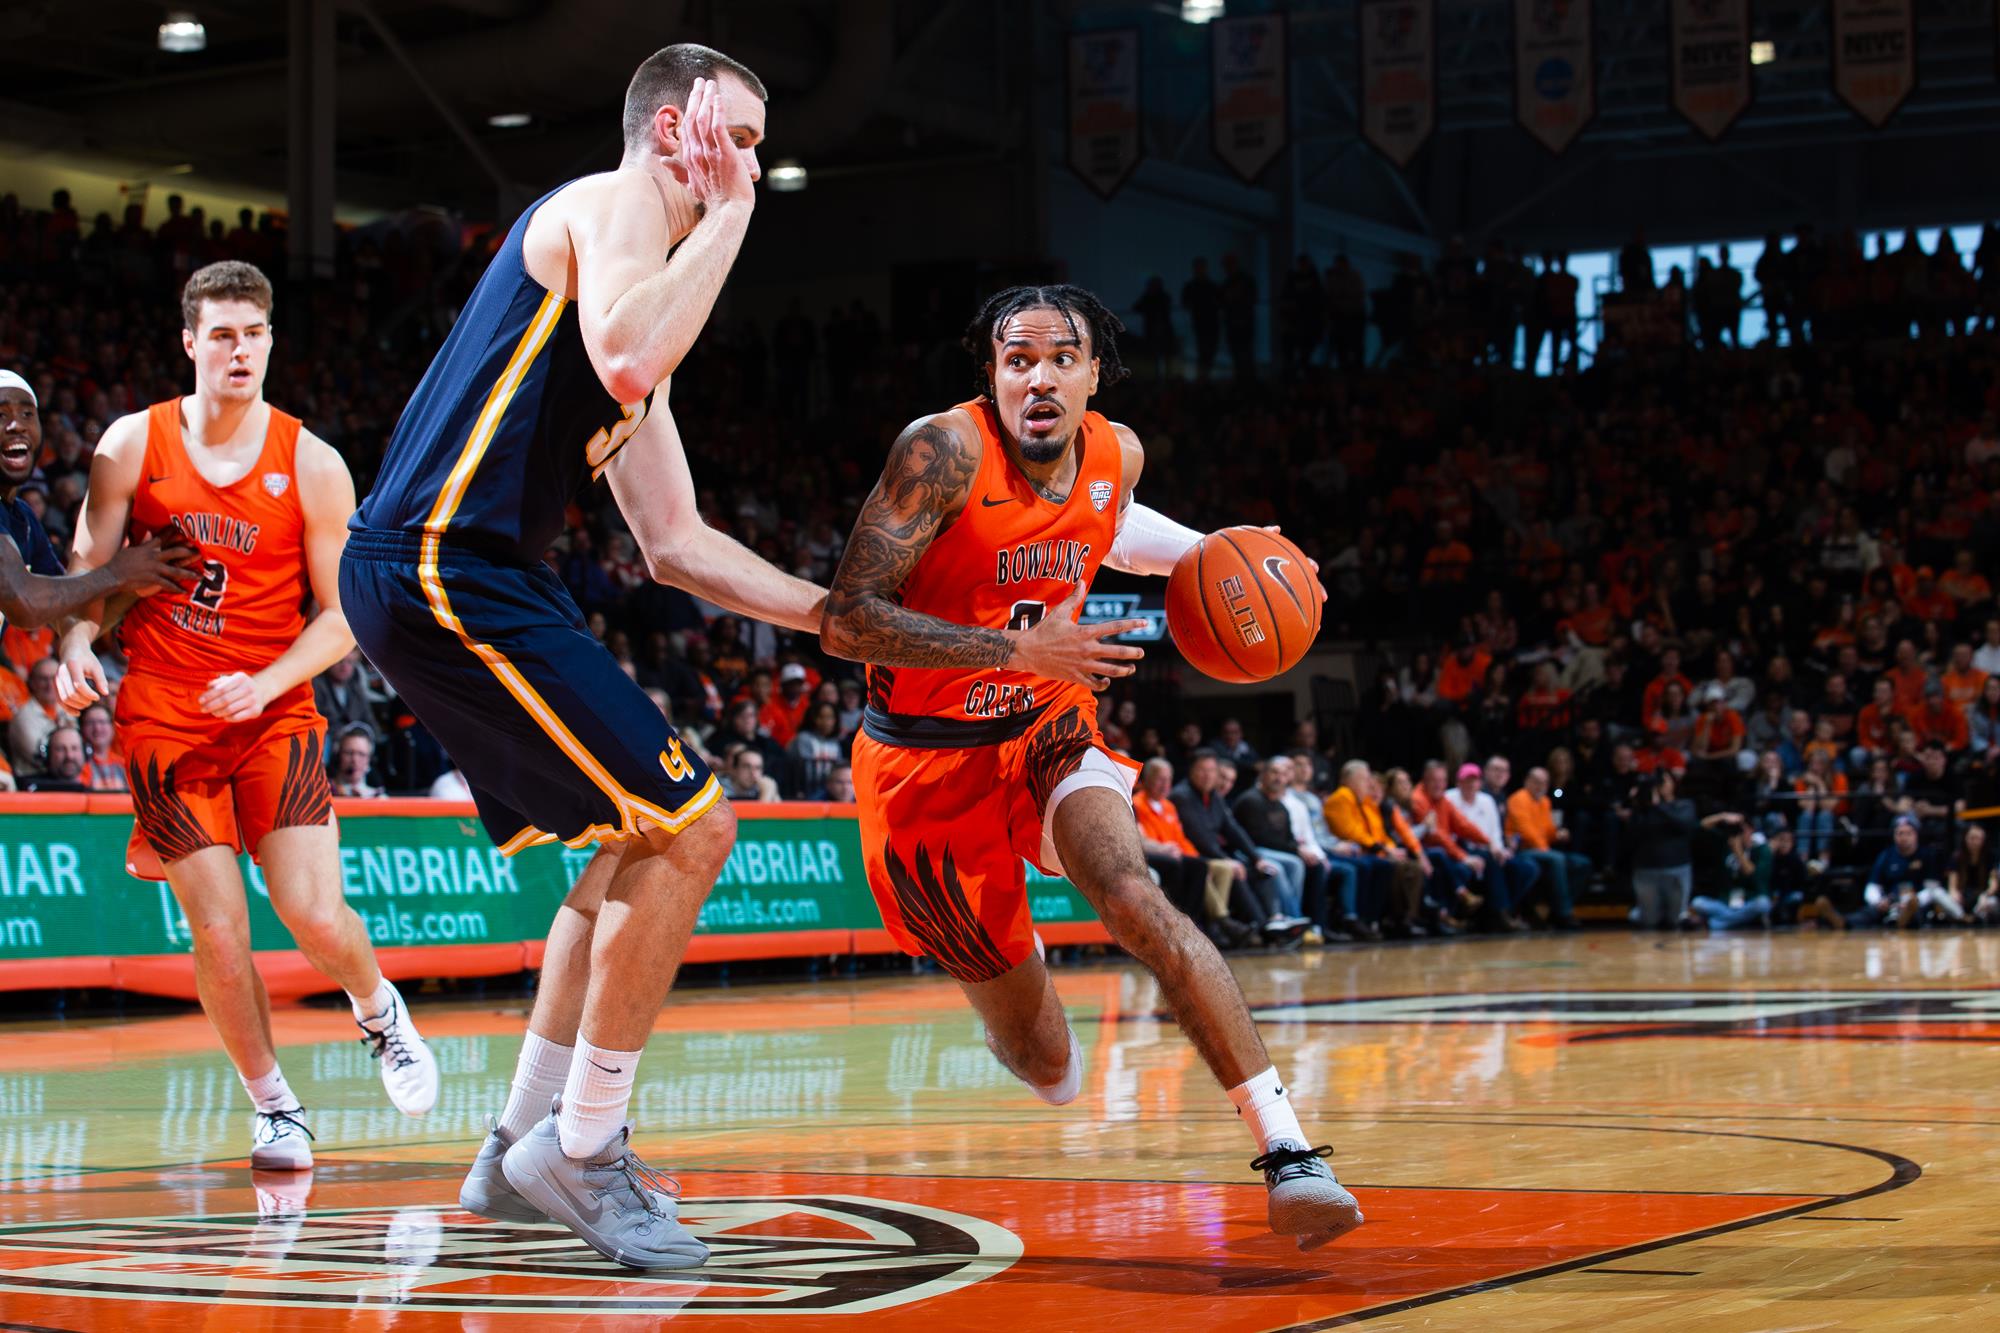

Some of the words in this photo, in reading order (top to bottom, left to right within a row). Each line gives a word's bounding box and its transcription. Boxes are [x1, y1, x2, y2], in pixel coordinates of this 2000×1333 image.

[190, 559, 228, 611] 2
[996, 539, 1090, 585] BOWLING
[1221, 575, 1266, 646] ELITE
[964, 680, 1035, 717] GREEN
